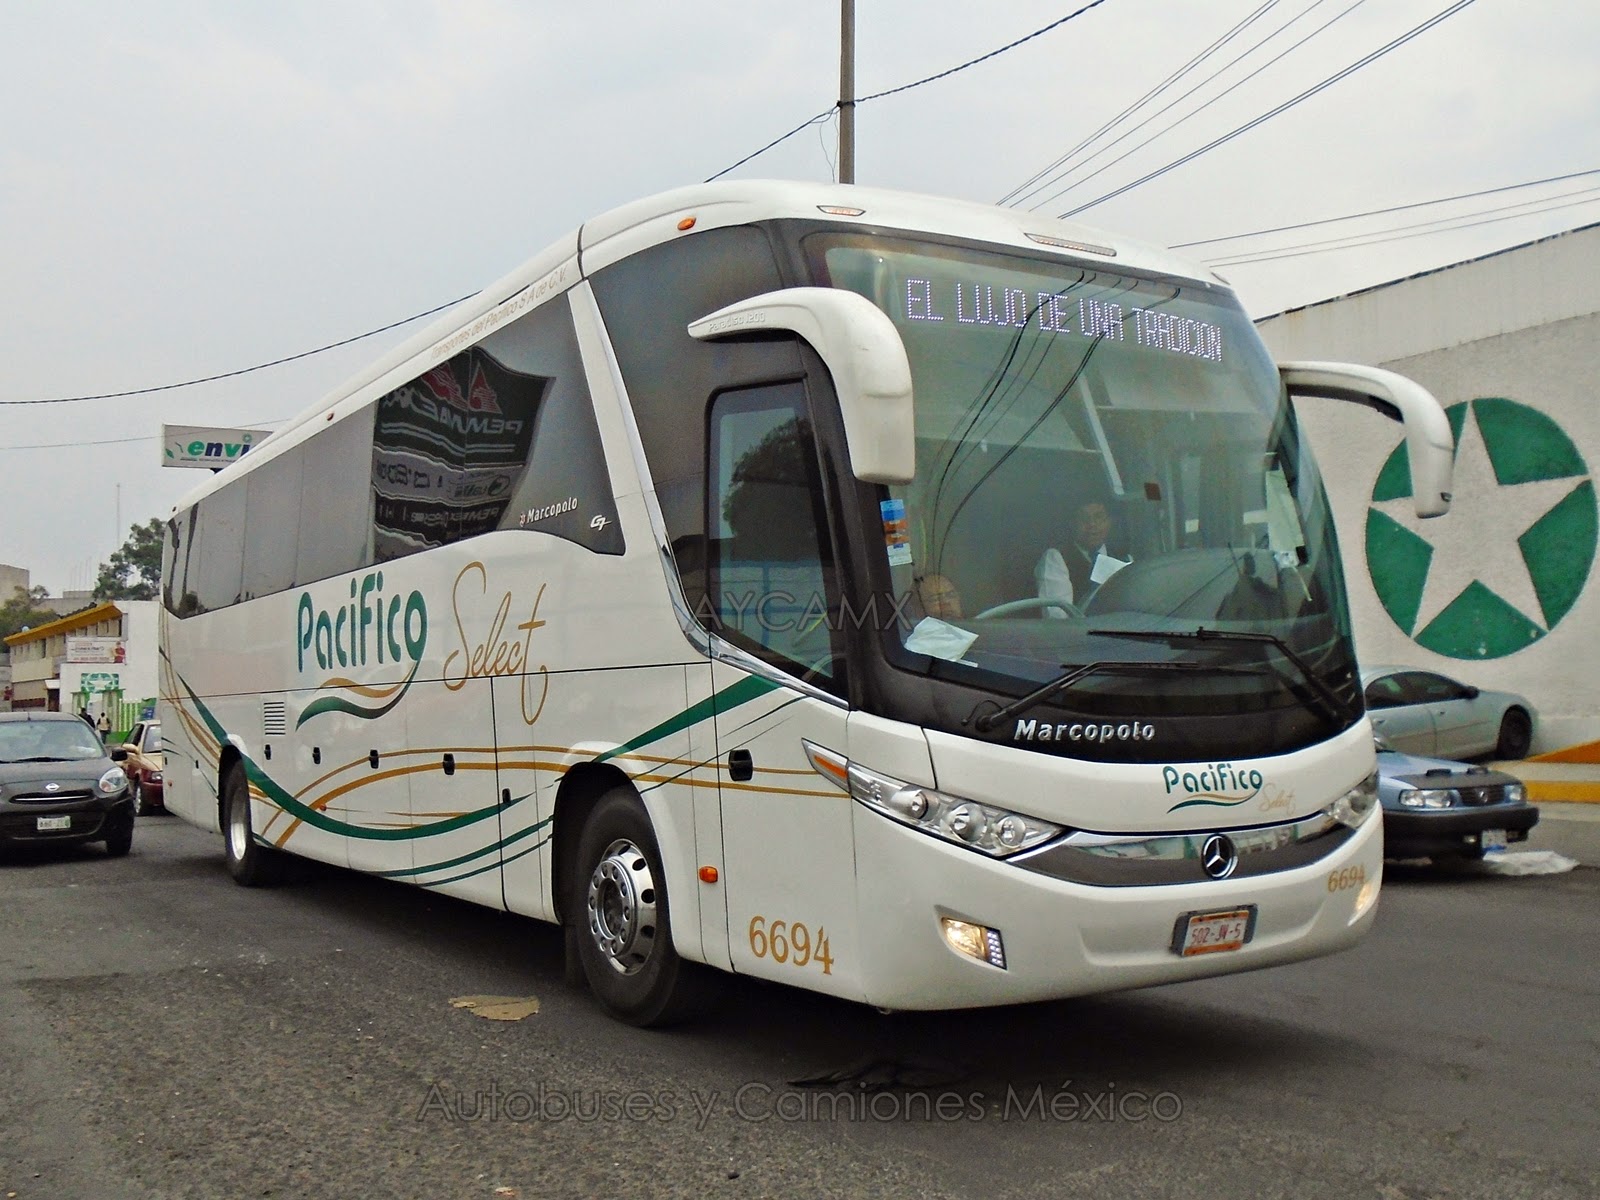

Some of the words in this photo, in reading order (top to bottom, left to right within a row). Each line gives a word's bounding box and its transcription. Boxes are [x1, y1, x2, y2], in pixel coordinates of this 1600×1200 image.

[906, 278, 944, 322] EL
[956, 283, 1027, 328] LUJO
[1037, 292, 1070, 334] DE
[1079, 298, 1125, 342] UNA
[1131, 307, 1223, 362] TRADICION
[526, 496, 578, 524] Marcopolo
[443, 561, 548, 725] Select
[1013, 719, 1156, 744] Marcopolo
[1327, 864, 1367, 894] 6694
[749, 915, 834, 976] 6694
